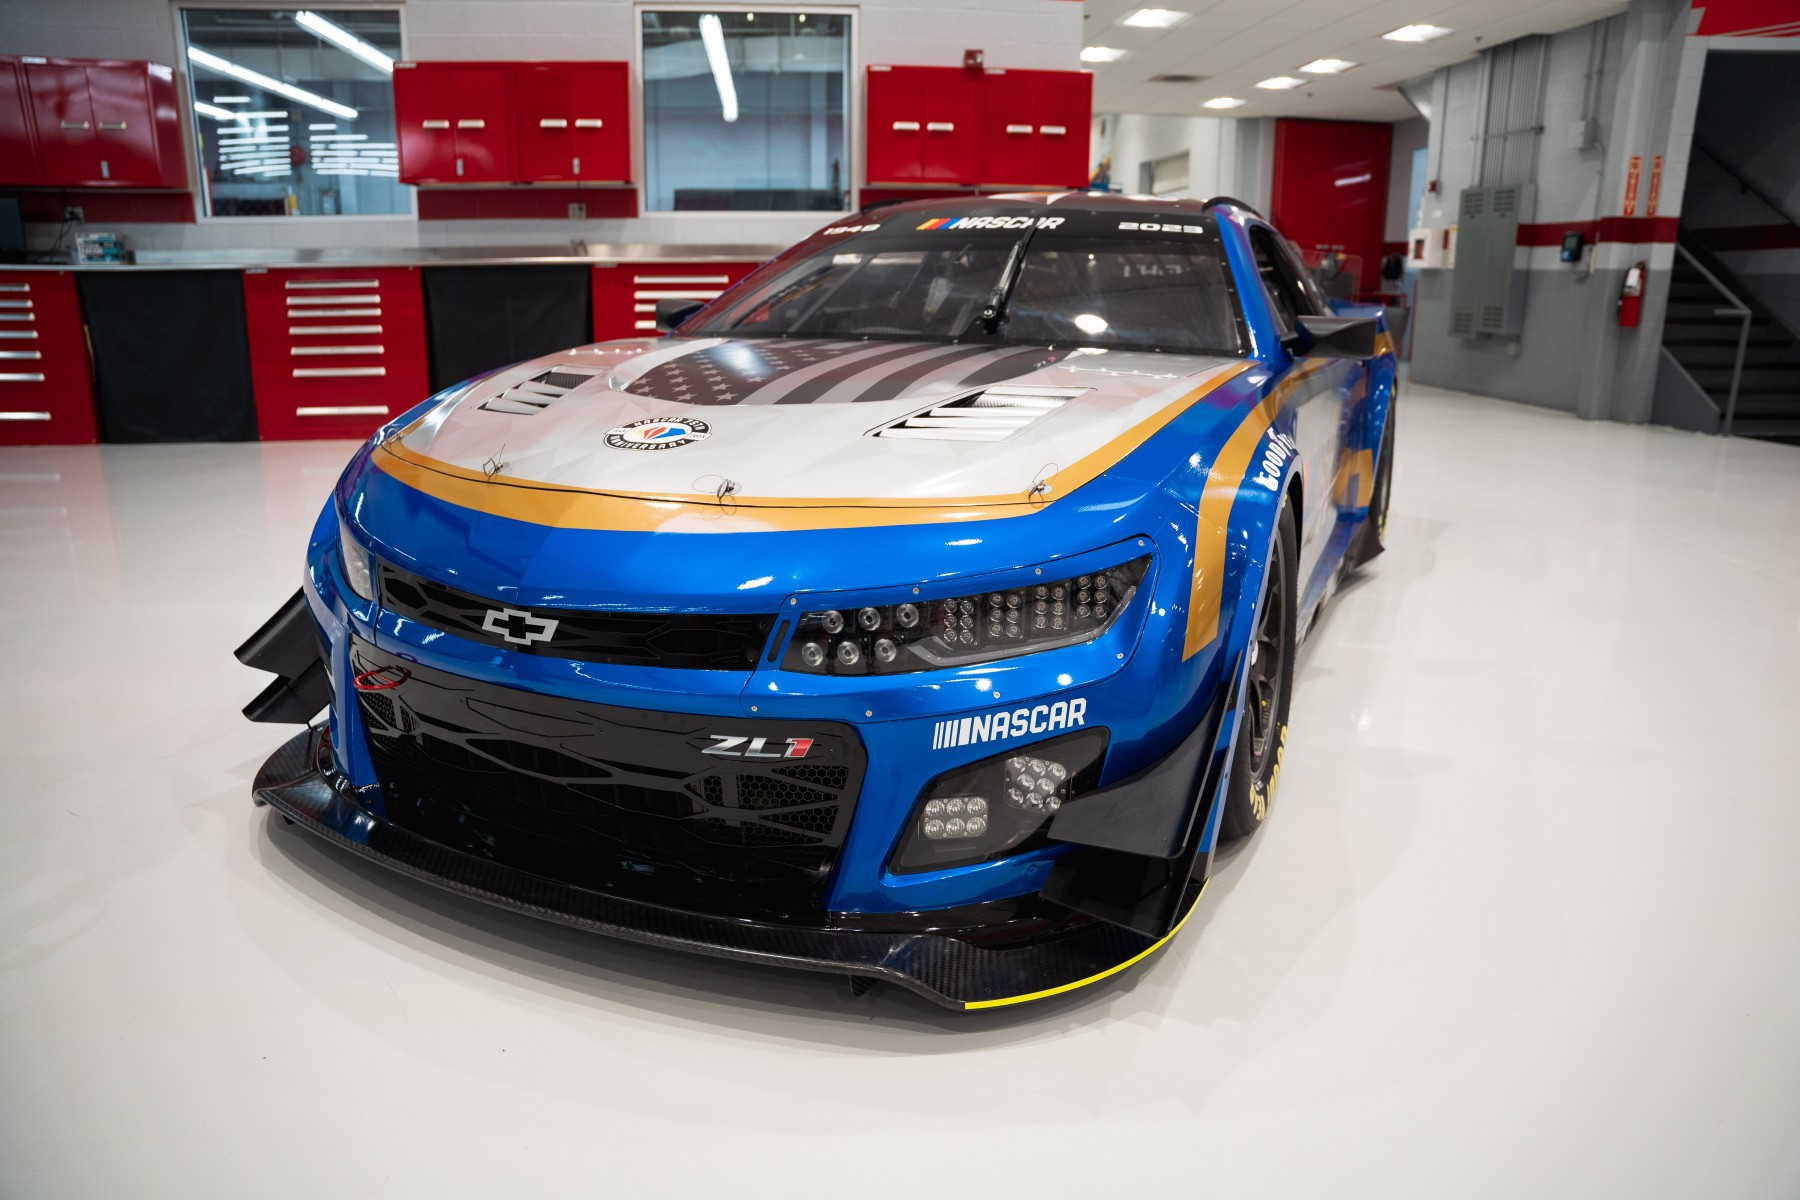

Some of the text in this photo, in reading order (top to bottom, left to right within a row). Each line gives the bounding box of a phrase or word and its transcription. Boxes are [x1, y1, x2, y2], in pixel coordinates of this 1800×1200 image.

[949, 216, 1066, 230] NASCAR
[1118, 221, 1204, 234] 2023
[633, 417, 706, 431] NASCAR 75TH
[610, 435, 688, 450] ANNIVERSARY
[1252, 426, 1297, 492] GOODY
[970, 697, 1088, 744] NASCAR
[701, 734, 815, 758] ZL1
